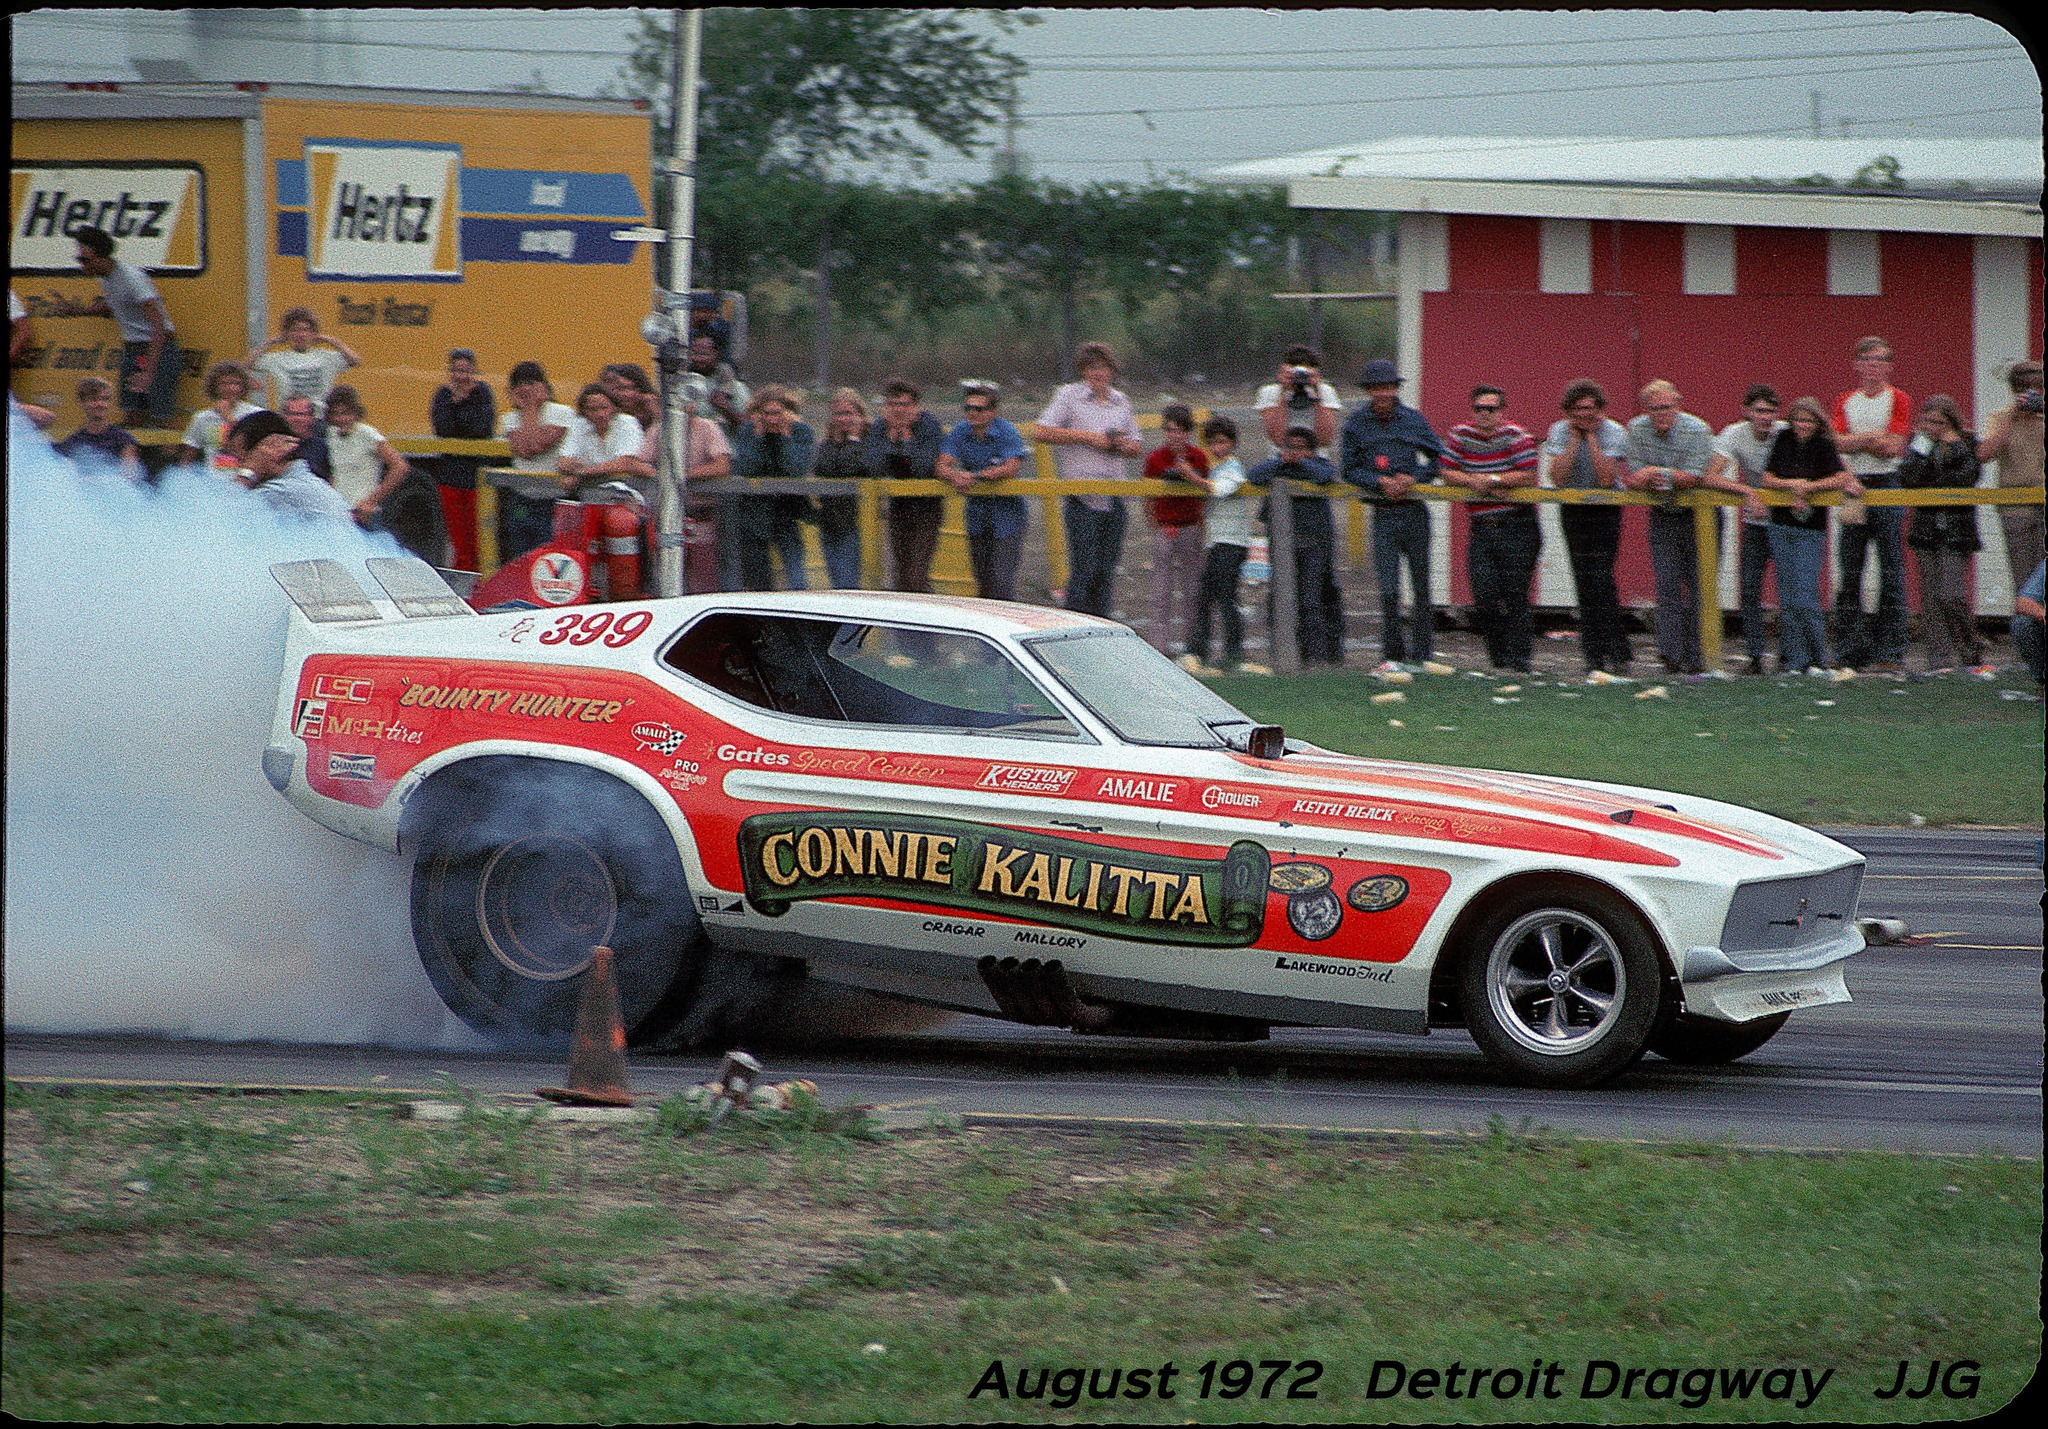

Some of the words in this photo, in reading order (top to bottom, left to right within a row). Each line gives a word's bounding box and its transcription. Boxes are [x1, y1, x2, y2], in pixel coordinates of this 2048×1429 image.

[22, 190, 169, 238] Hertz
[333, 181, 434, 242] Hertz
[538, 610, 654, 649] 399
[315, 677, 372, 702] LSC
[385, 720, 425, 745] tires
[634, 725, 669, 740] AMALIE
[674, 758, 699, 773] PRO
[716, 743, 790, 766] Gates
[792, 750, 866, 773] Speed
[867, 756, 946, 780] Center
[979, 763, 1074, 787] KUSTOM
[1000, 779, 1061, 792] HEADERS
[1097, 777, 1177, 803] AMALIE
[1292, 800, 1344, 816] KEITH
[760, 826, 958, 888] CONNIE
[976, 842, 1208, 925] KALITTA
[922, 921, 986, 937] CRAGAR
[1013, 931, 1087, 949] MALLORY
[1274, 957, 1356, 976] LAKEWOOD
